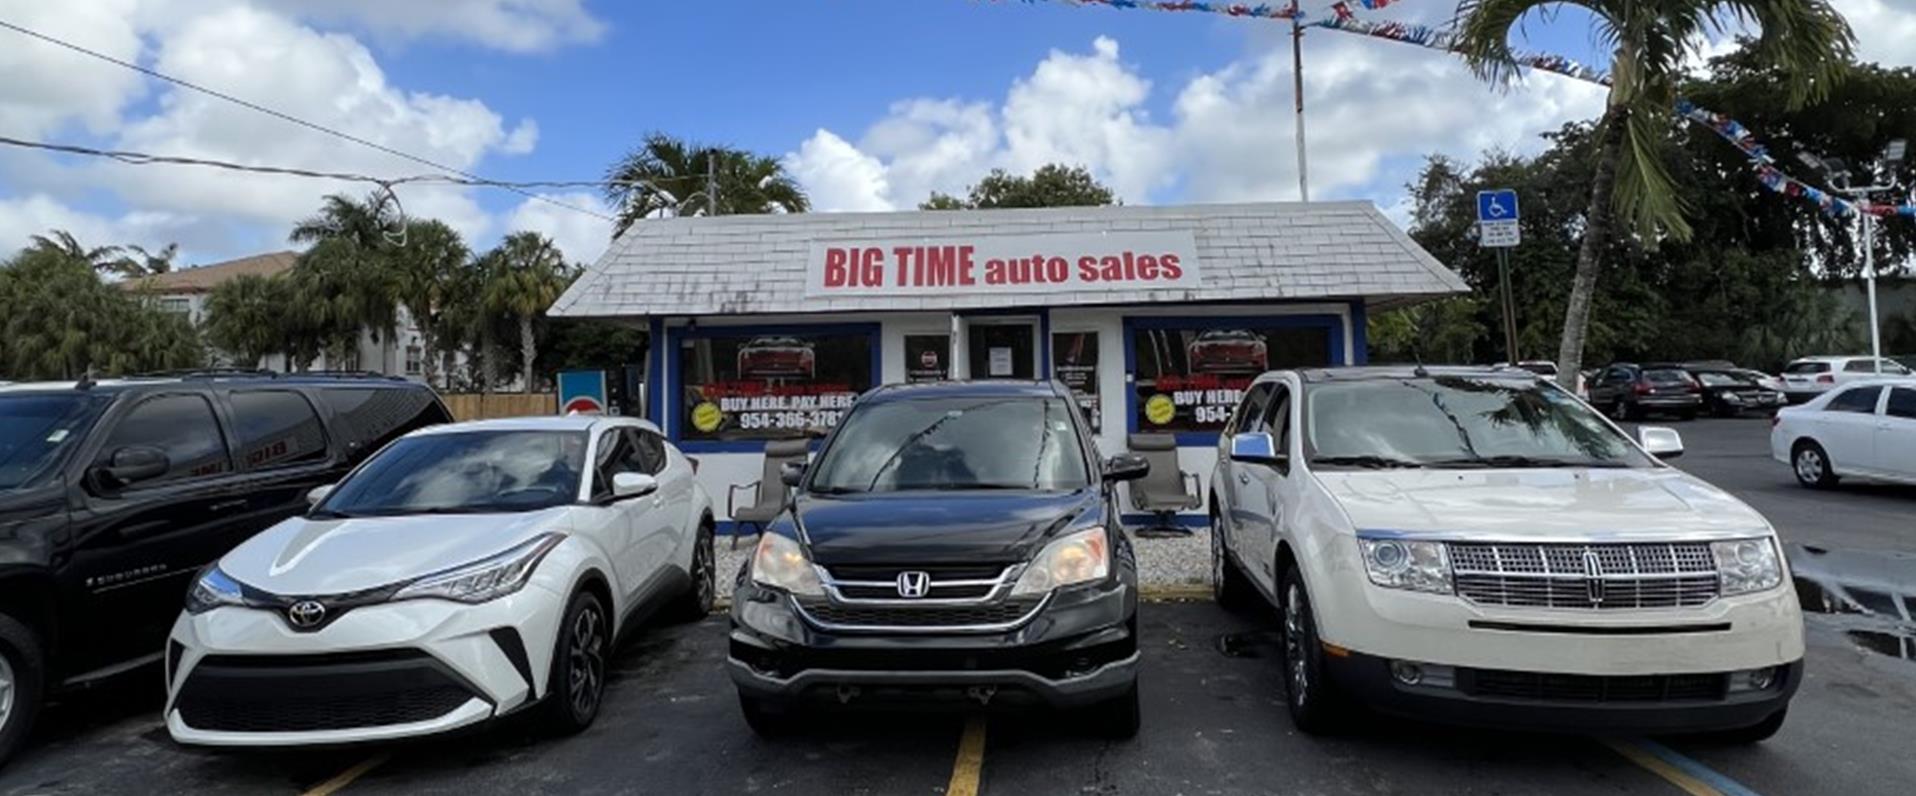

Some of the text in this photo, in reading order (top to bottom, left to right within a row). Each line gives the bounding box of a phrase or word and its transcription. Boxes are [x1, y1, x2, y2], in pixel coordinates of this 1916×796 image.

[824, 245, 1182, 287] BIG TIME auto sales
[720, 397, 748, 411] BUY
[791, 395, 817, 409] PAY
[819, 394, 855, 408] HERE
[1173, 390, 1203, 405] BUY
